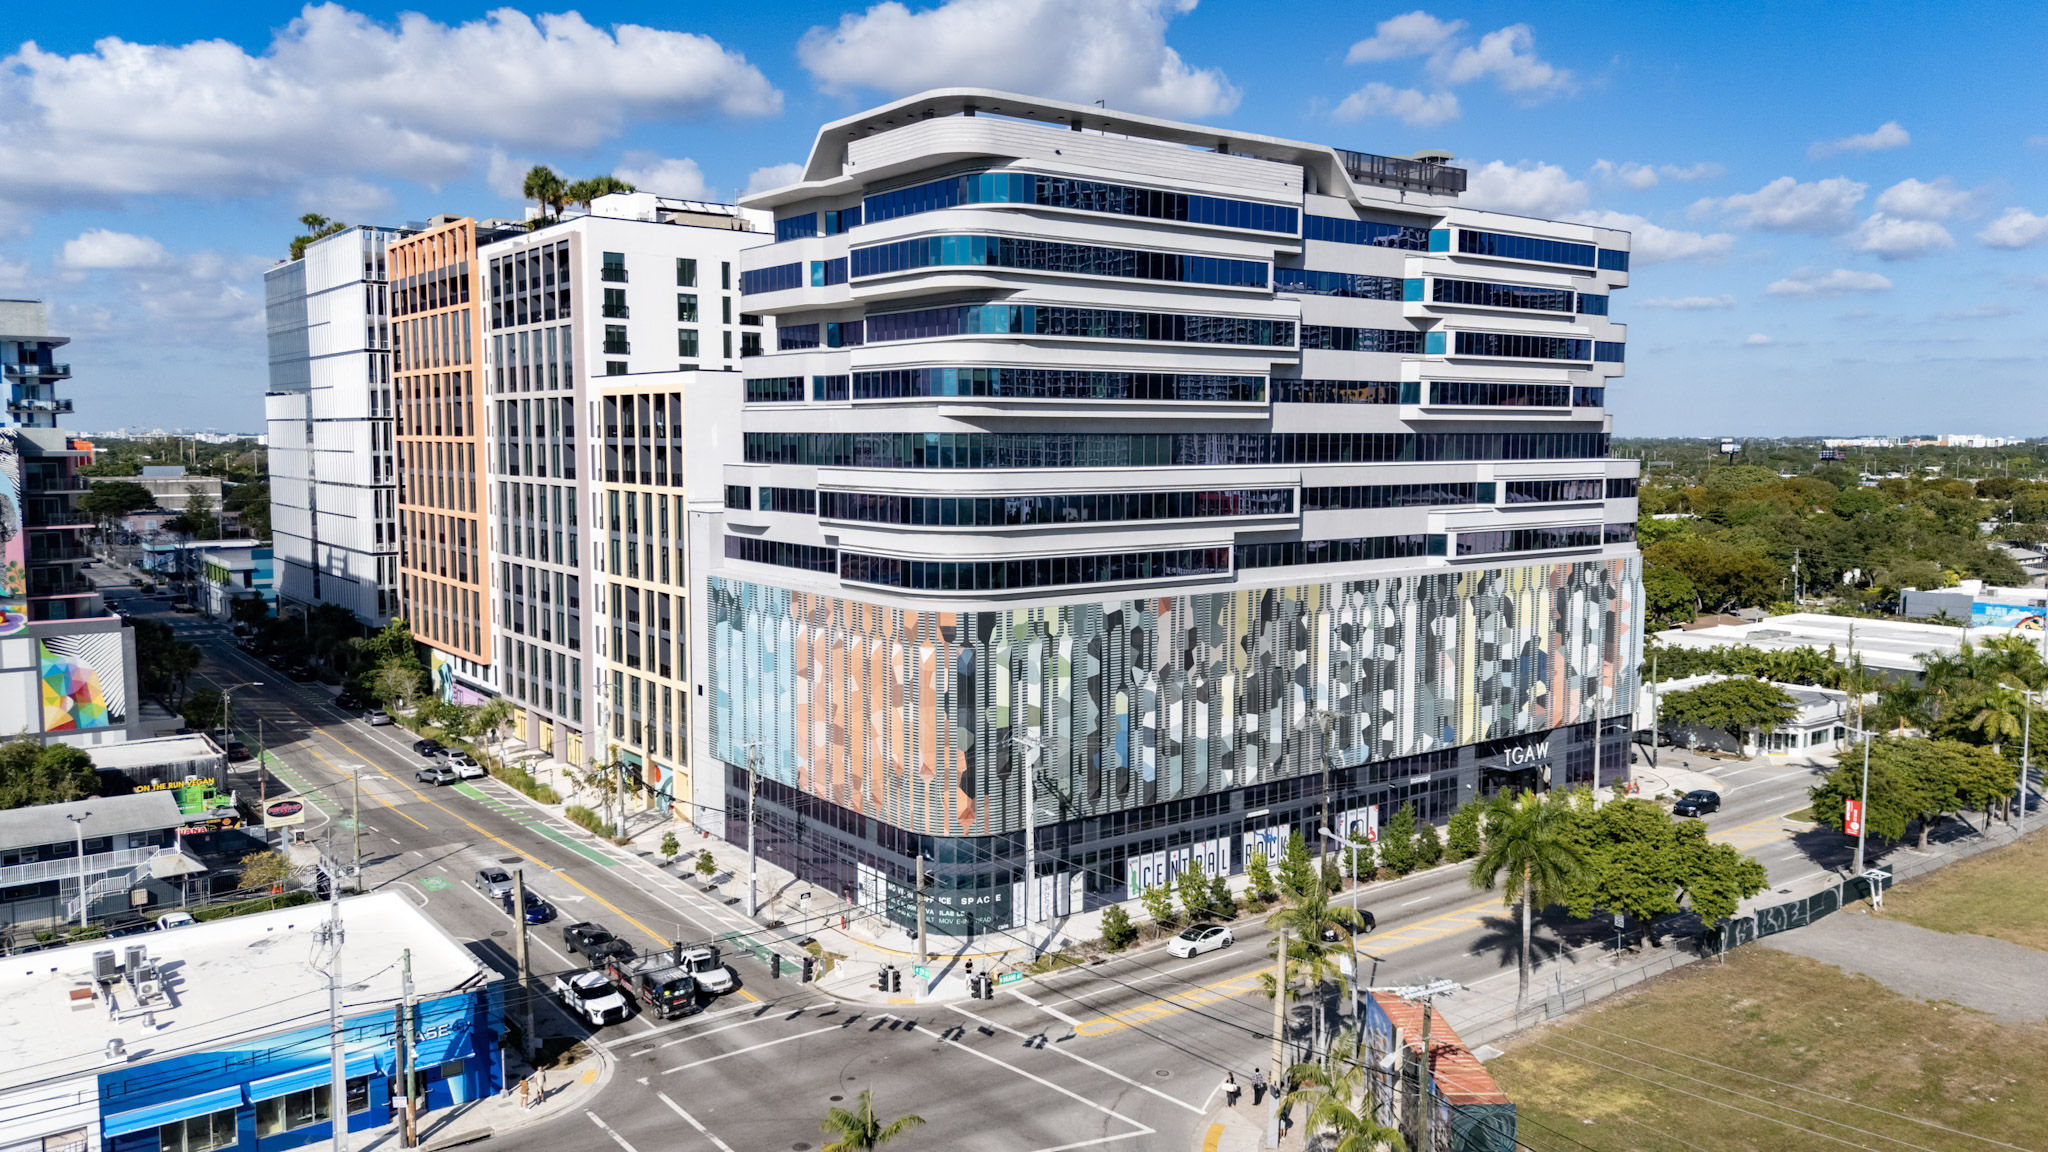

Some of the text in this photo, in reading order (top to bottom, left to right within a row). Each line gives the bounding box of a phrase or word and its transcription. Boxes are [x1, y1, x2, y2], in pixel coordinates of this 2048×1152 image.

[1504, 741, 1549, 767] TGAW
[135, 777, 215, 793] ON THE RUN VEGAN
[1245, 834, 1289, 866] ROCK
[960, 893, 1002, 906] SPACE
[387, 1023, 451, 1049] CASE
